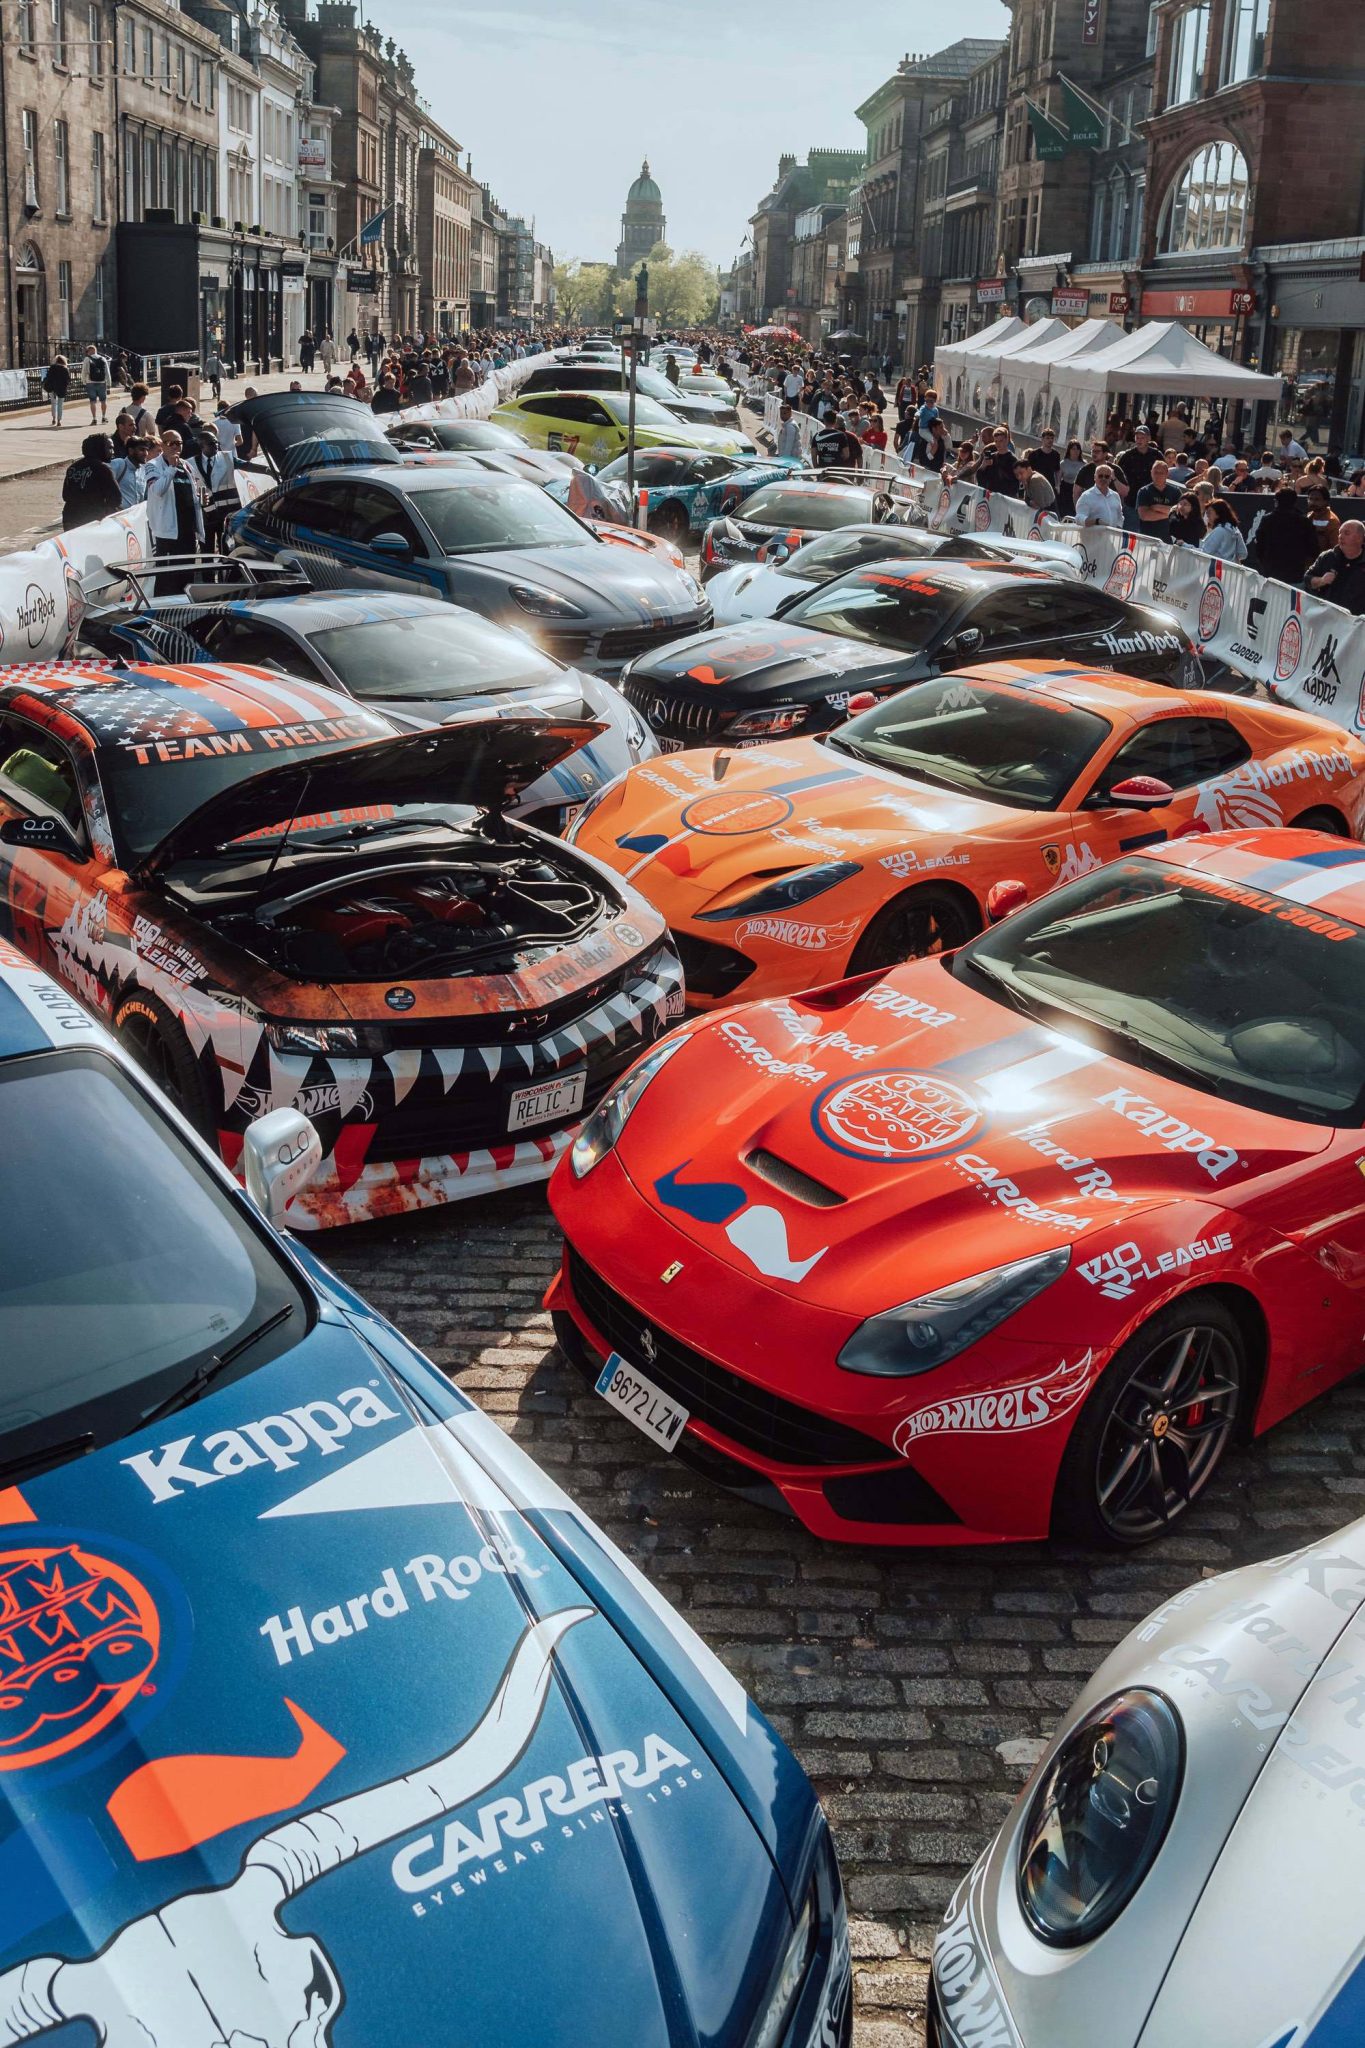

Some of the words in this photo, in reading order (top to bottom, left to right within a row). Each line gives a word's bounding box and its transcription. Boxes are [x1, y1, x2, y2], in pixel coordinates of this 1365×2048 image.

[1073, 132, 1098, 140] ROLEX
[990, 288, 1003, 296] LET
[1055, 299, 1066, 307] TO
[1069, 300, 1086, 308] LET
[17, 604, 36, 631] Hard
[37, 592, 56, 624] Rock
[1101, 631, 1147, 655] Hard
[1140, 629, 1186, 656] Rock
[1229, 642, 1263, 665] CARRERA
[1303, 677, 1338, 706] Kappa
[125, 733, 253, 765] TEAM
[259, 718, 369, 749] RELIC
[1243, 753, 1310, 792] Hard
[1302, 746, 1357, 781] Rock
[341, 804, 395, 824] 3000
[769, 827, 847, 858] CARRERA
[1162, 871, 1284, 914] GUMBALL
[1276, 907, 1358, 942] 3000
[155, 935, 209, 980] MICHELIN
[538, 962, 578, 989] TEAM
[577, 945, 614, 972] RELIC
[28, 984, 94, 1030] CLARK
[116, 1001, 158, 1029] MICHELIN
[816, 1031, 880, 1061] Rock
[515, 1082, 555, 1099] WISCONSIN
[517, 1091, 562, 1120] RELIC
[1092, 1086, 1239, 1181] Kappa
[944, 1160, 998, 1206] EYEWEAR
[1009, 1126, 1095, 1171] Hard
[1074, 1165, 1144, 1206] Ro
[955, 1153, 1094, 1230] CARRERA
[1075, 1241, 1142, 1285] V10
[610, 1370, 650, 1416] 9672
[646, 1399, 683, 1440] LZW
[120, 1386, 401, 1505] Kappa
[260, 1569, 410, 1666] Hard
[404, 1535, 545, 1605] Rock
[1158, 1643, 1365, 1810] CARRE
[391, 1732, 692, 1895] CARRERA
[411, 1838, 546, 1918] EYEWEAR
[561, 1802, 634, 1839] SINCE
[646, 1767, 703, 1803] 1956
